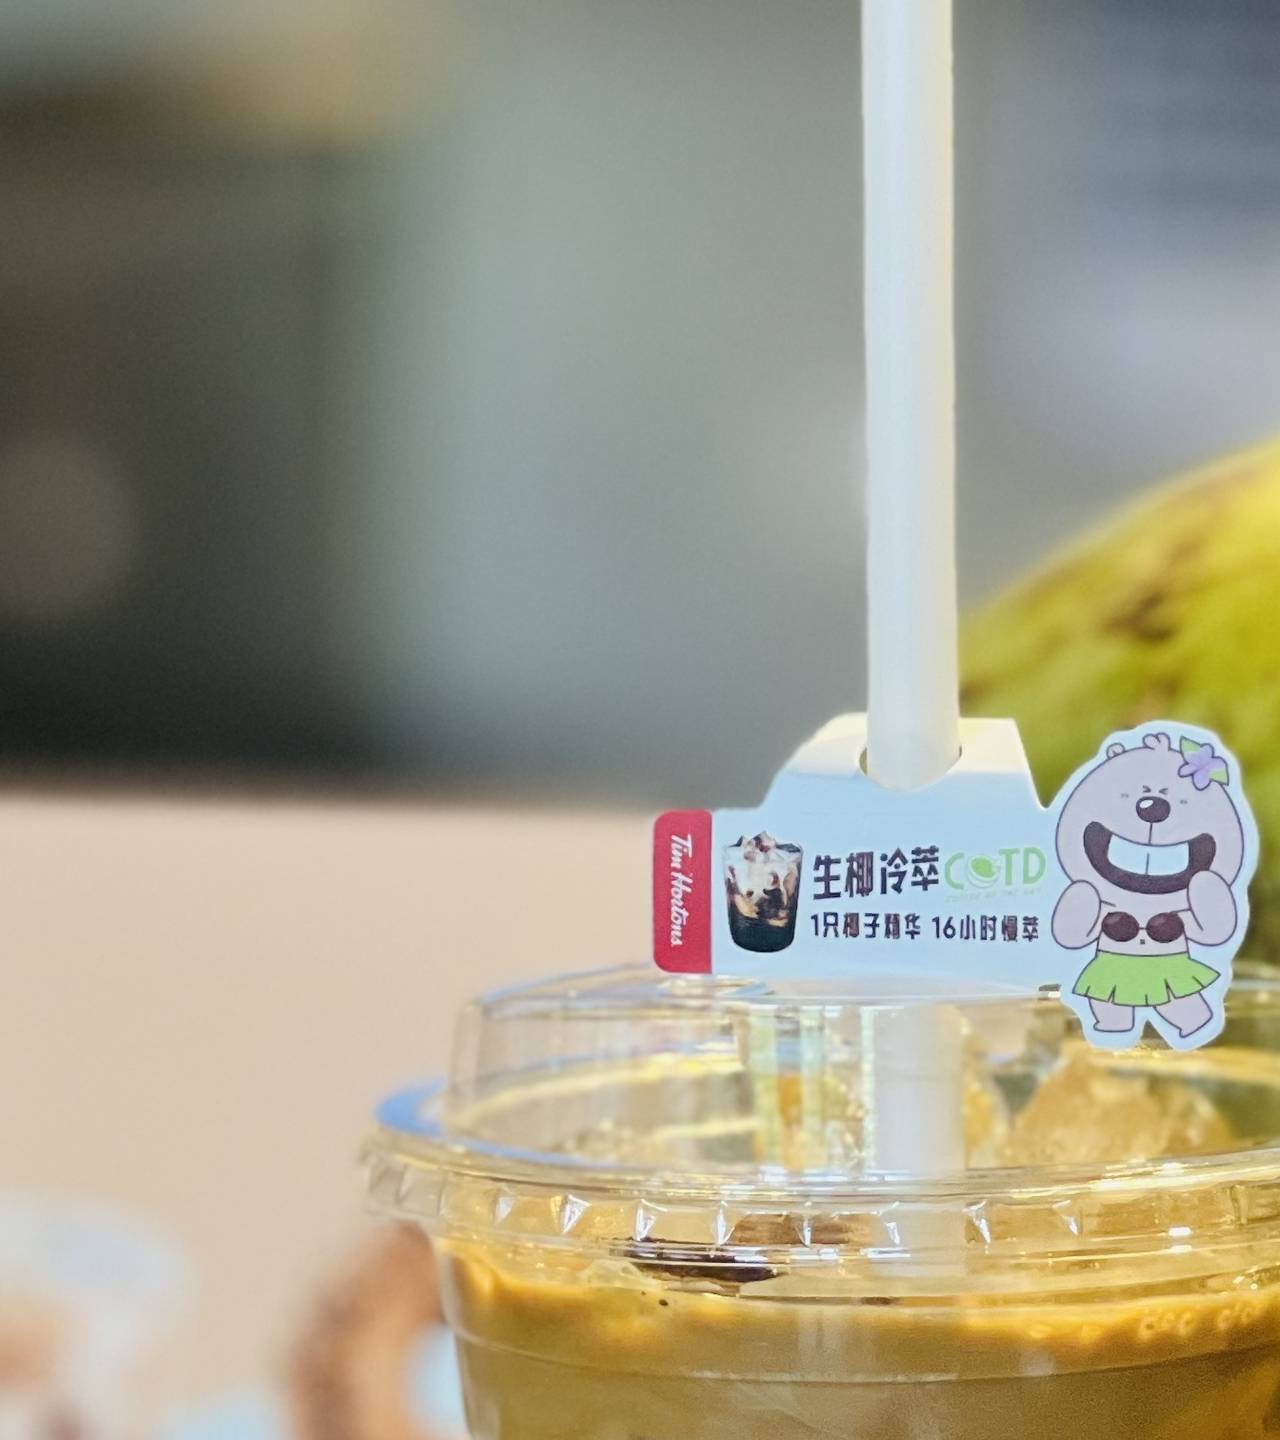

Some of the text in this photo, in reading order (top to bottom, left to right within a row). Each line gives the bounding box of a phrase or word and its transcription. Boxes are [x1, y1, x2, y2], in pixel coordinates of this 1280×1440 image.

[670, 833, 694, 947] Tim Hortons
[813, 845, 940, 900] 生椰冷萃
[810, 911, 1039, 942] 1只椰子精华 16小时慢萃
